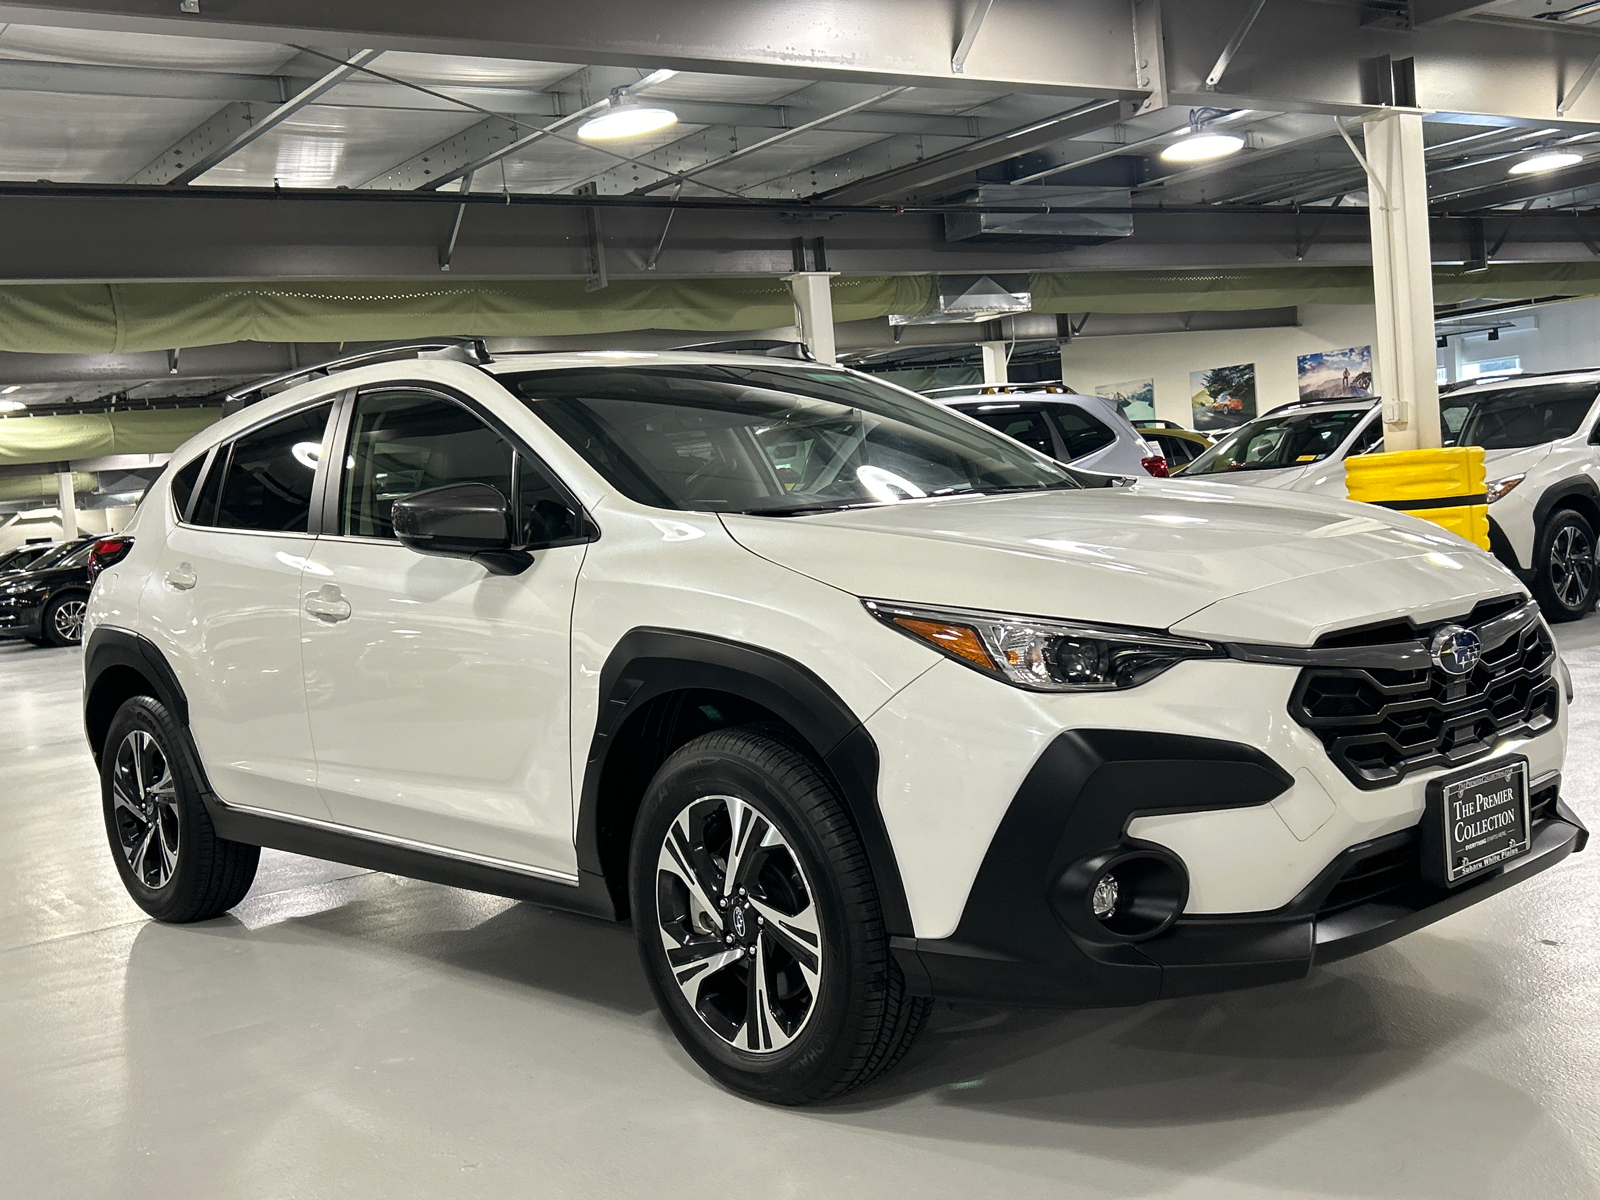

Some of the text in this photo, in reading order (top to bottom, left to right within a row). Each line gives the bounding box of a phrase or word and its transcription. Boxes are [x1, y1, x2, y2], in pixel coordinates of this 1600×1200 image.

[1453, 788, 1514, 821] THE PREMIER
[1455, 809, 1515, 843] COLLECTION
[1461, 847, 1519, 876] Subaru White Plains
